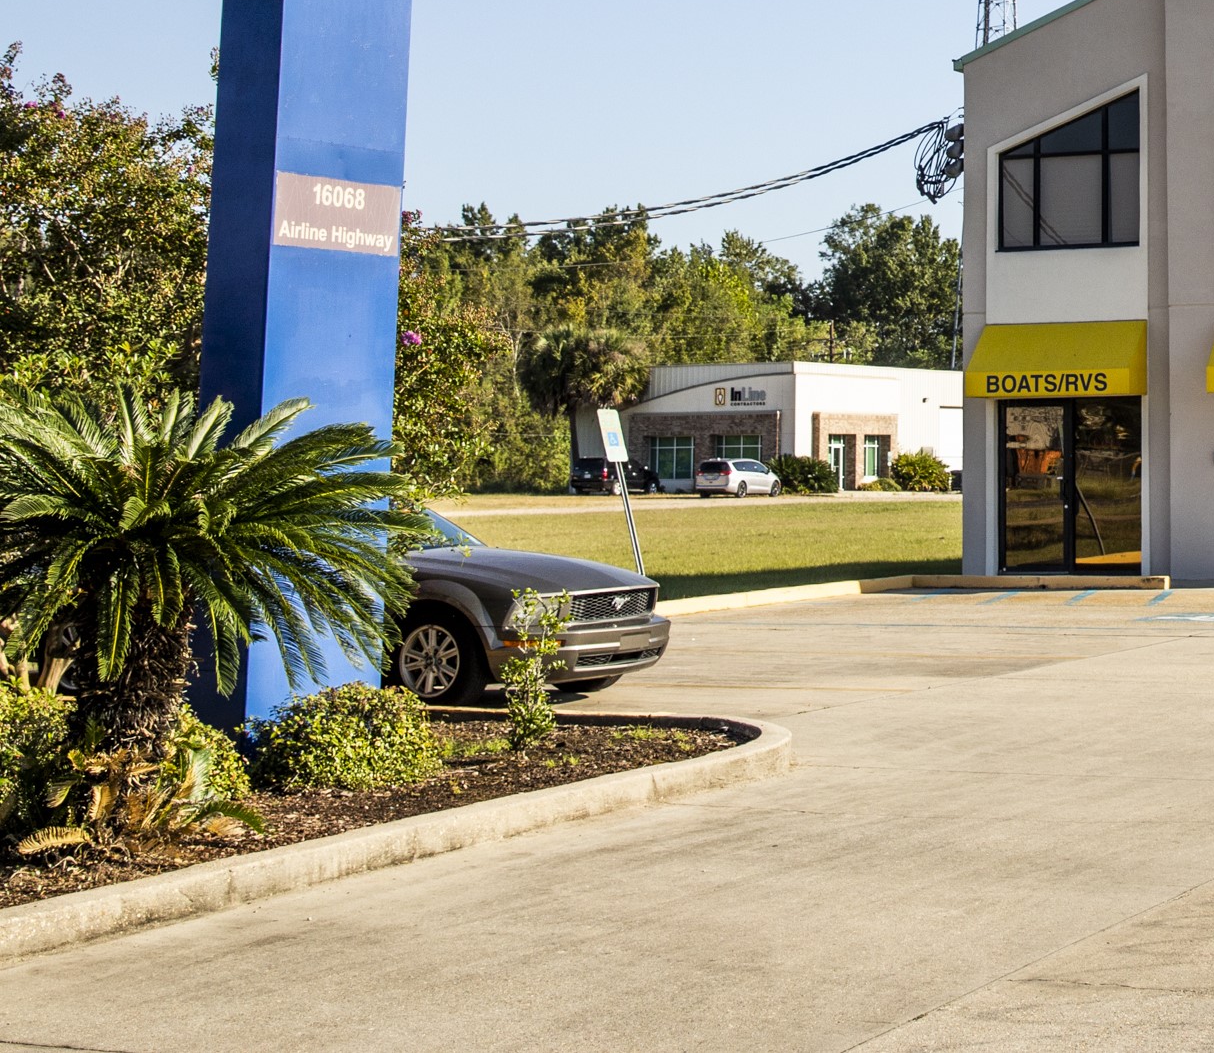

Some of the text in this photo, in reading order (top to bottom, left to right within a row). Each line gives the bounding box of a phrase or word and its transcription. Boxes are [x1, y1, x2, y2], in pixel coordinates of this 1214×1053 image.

[313, 183, 365, 210] 16068
[278, 219, 394, 252] Airline Highway
[730, 386, 767, 402] InLine
[986, 372, 1108, 394] BOATS/RVS
